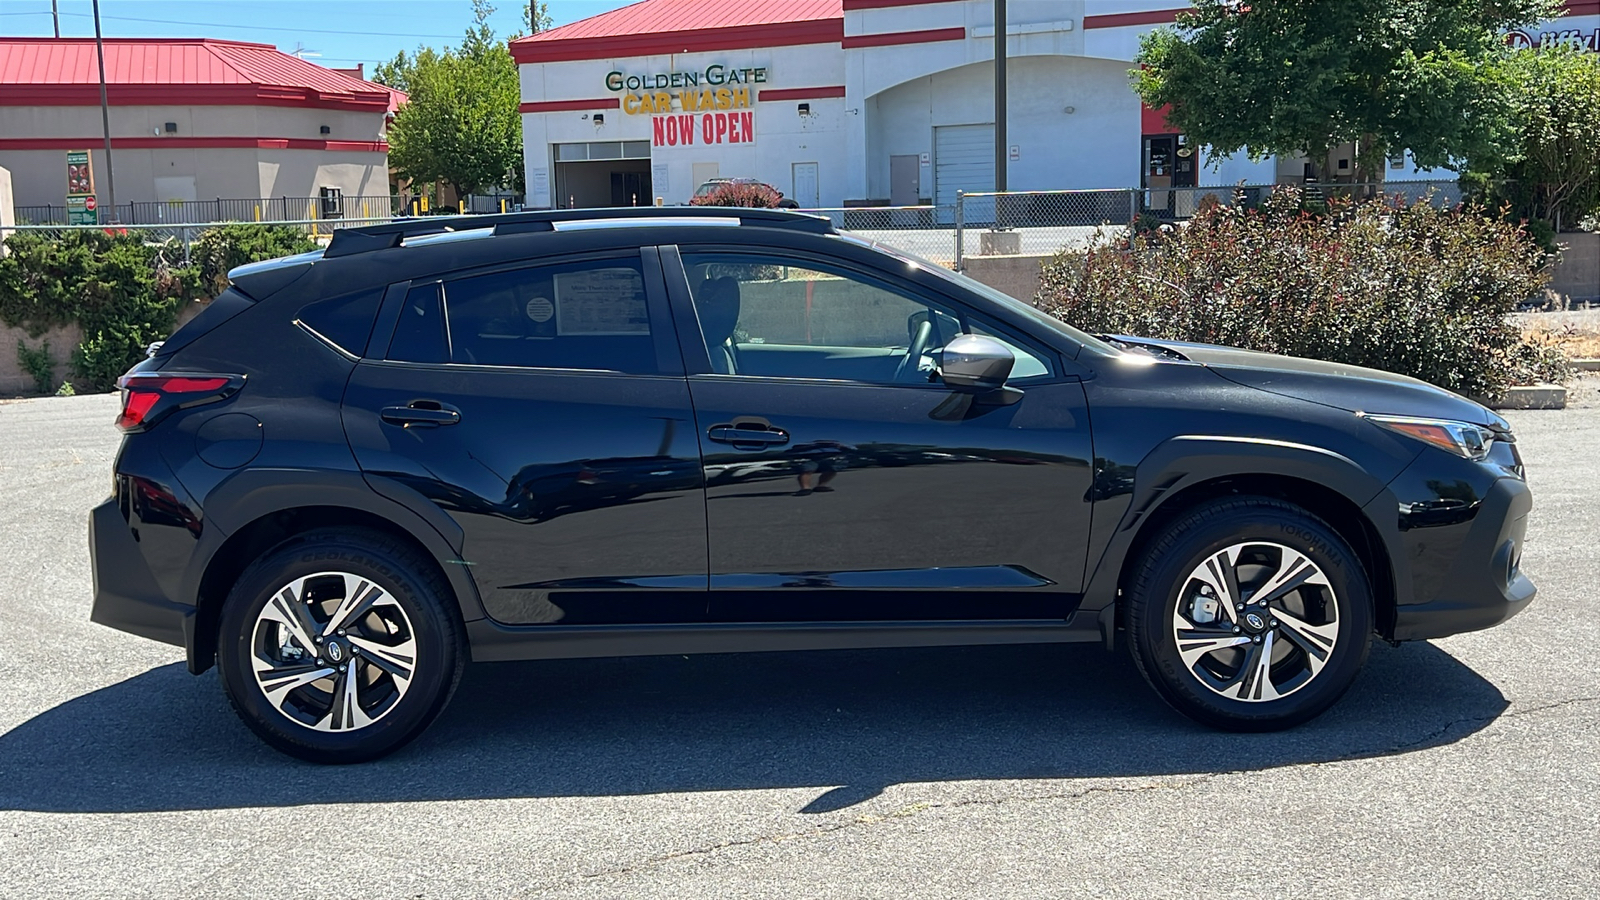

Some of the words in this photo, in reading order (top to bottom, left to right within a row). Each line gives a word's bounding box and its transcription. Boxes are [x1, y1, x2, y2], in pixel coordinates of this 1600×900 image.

[605, 71, 698, 91] GOLDEN
[705, 64, 767, 85] GATE
[623, 92, 672, 115] CAR
[679, 88, 751, 112] WASH
[652, 114, 694, 147] NOW
[702, 111, 753, 145] OPEN
[1279, 522, 1343, 568] YOKOHAMA
